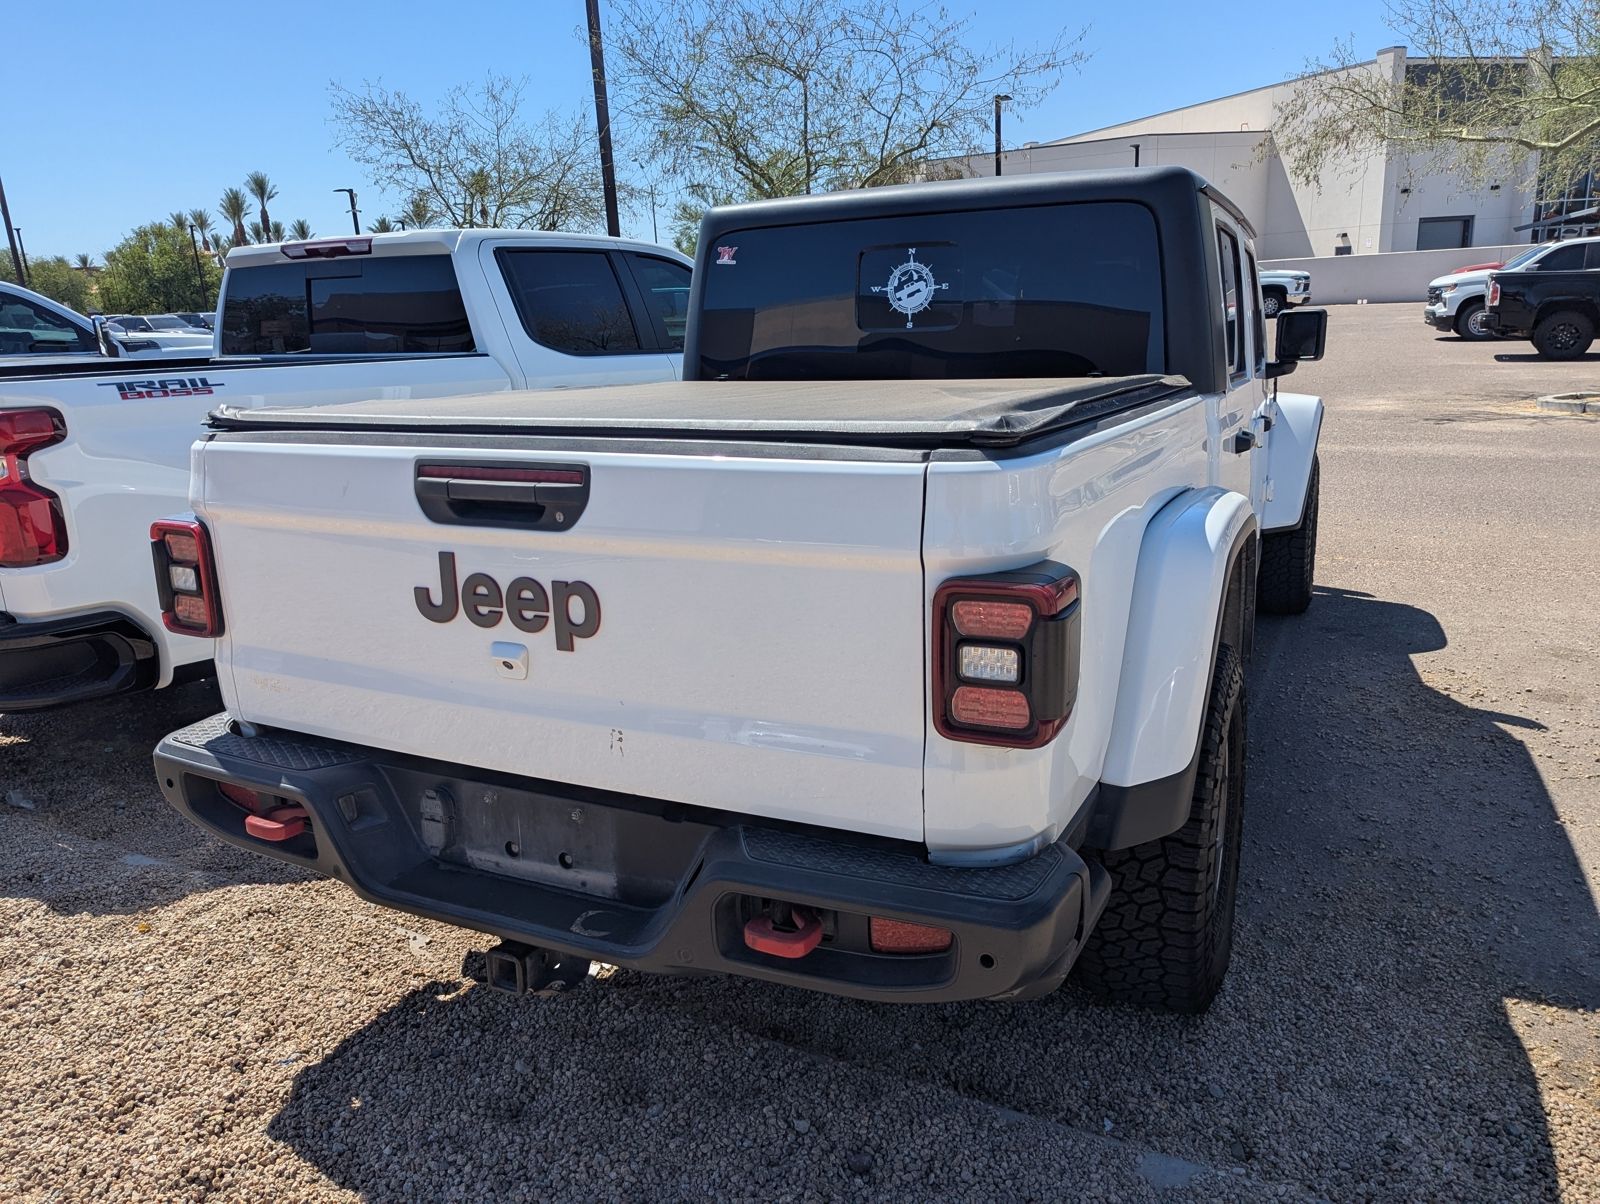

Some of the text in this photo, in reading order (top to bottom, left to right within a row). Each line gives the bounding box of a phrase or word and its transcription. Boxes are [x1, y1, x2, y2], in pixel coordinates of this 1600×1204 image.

[97, 377, 225, 391] TRAIL
[120, 387, 214, 400] BOSS
[413, 551, 601, 652] Jeep
